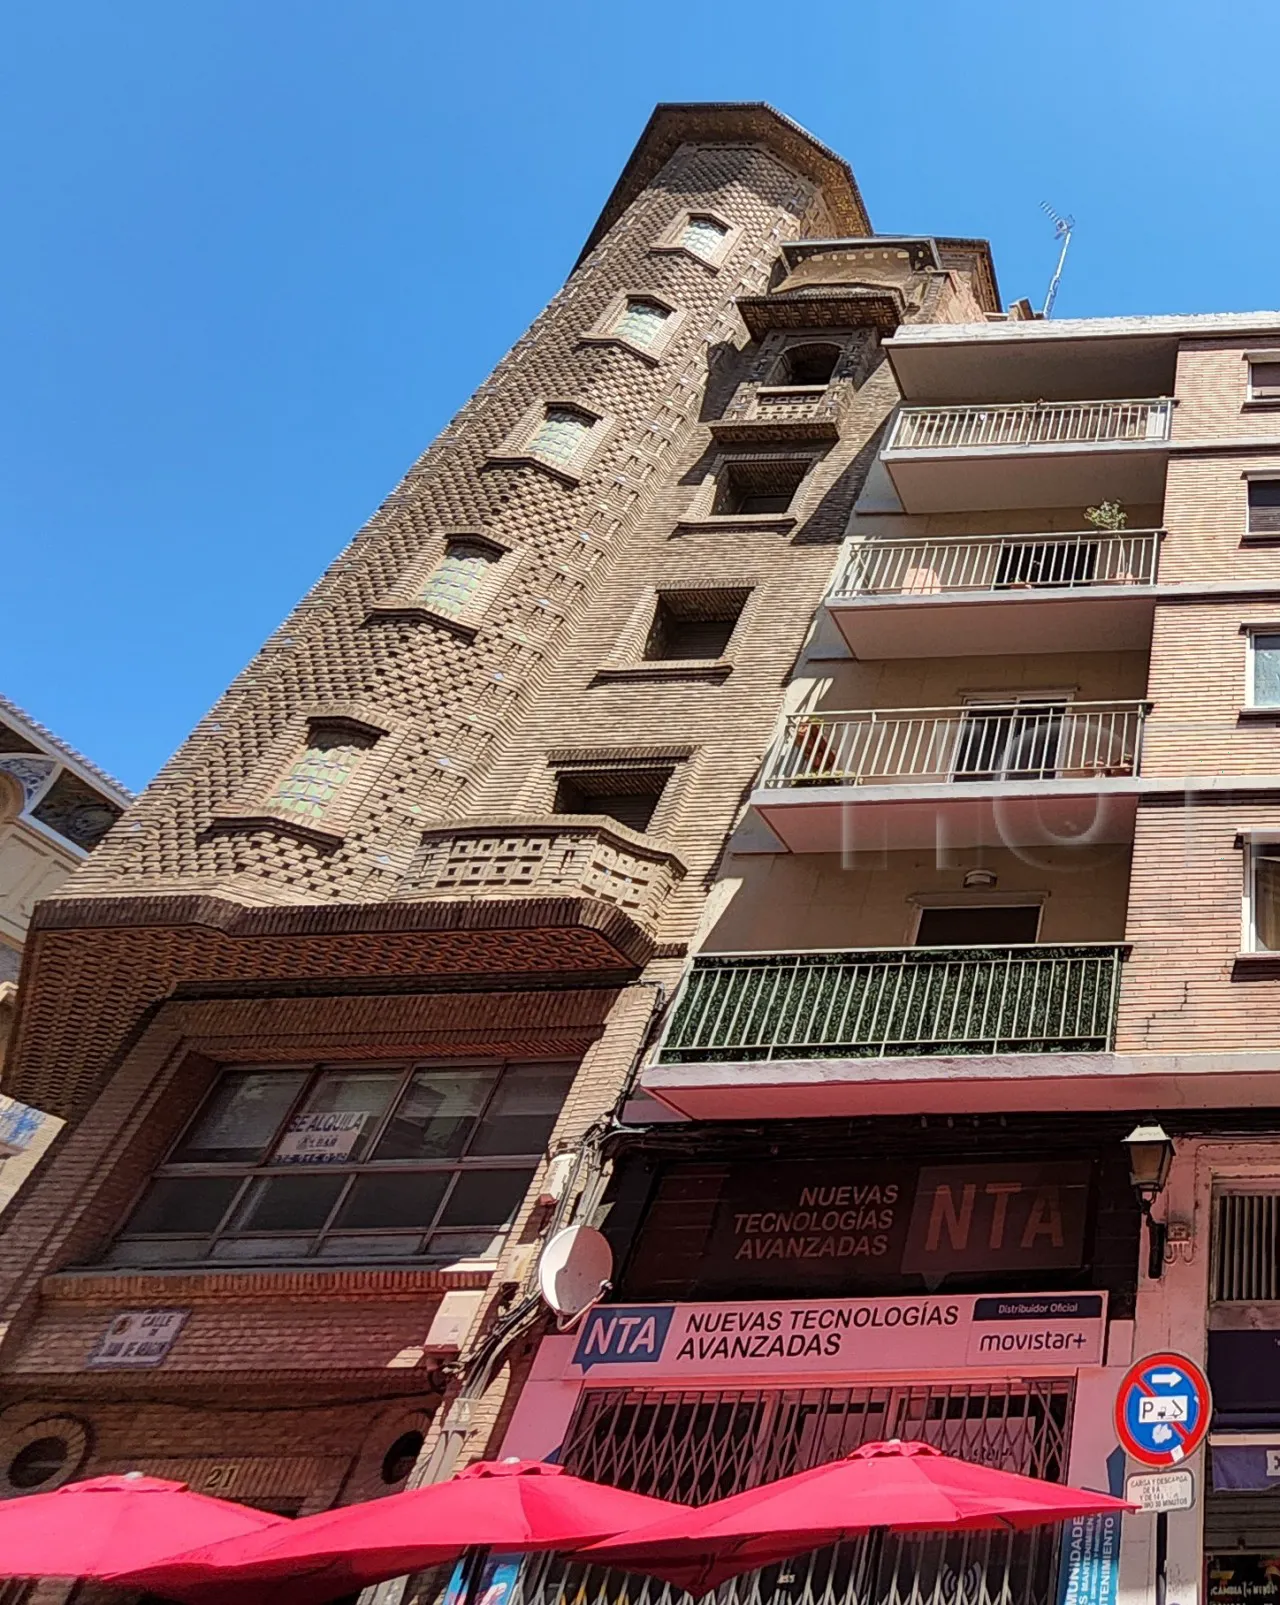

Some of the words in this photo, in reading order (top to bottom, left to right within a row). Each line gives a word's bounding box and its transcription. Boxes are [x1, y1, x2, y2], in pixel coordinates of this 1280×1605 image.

[306, 1113, 364, 1132] ALQUILA
[799, 1184, 899, 1207] NUEVAS
[734, 1205, 894, 1234] TECNOLOGÍAS
[925, 1182, 1064, 1250] NTA
[734, 1234, 889, 1260] AVANZADAS
[685, 1311, 783, 1334] NUEVAS
[790, 1301, 960, 1330] TECNOLOGÍAS
[998, 1304, 1048, 1314] Distribuidor
[1050, 1303, 1078, 1313] Oficial
[584, 1316, 656, 1355] NTA
[676, 1333, 842, 1360] AVANZADAS
[980, 1331, 1087, 1352] movistar+
[1142, 1401, 1154, 1420] P
[204, 1466, 238, 1489] 21
[1081, 1513, 1095, 1592] MANTENIMIEN
